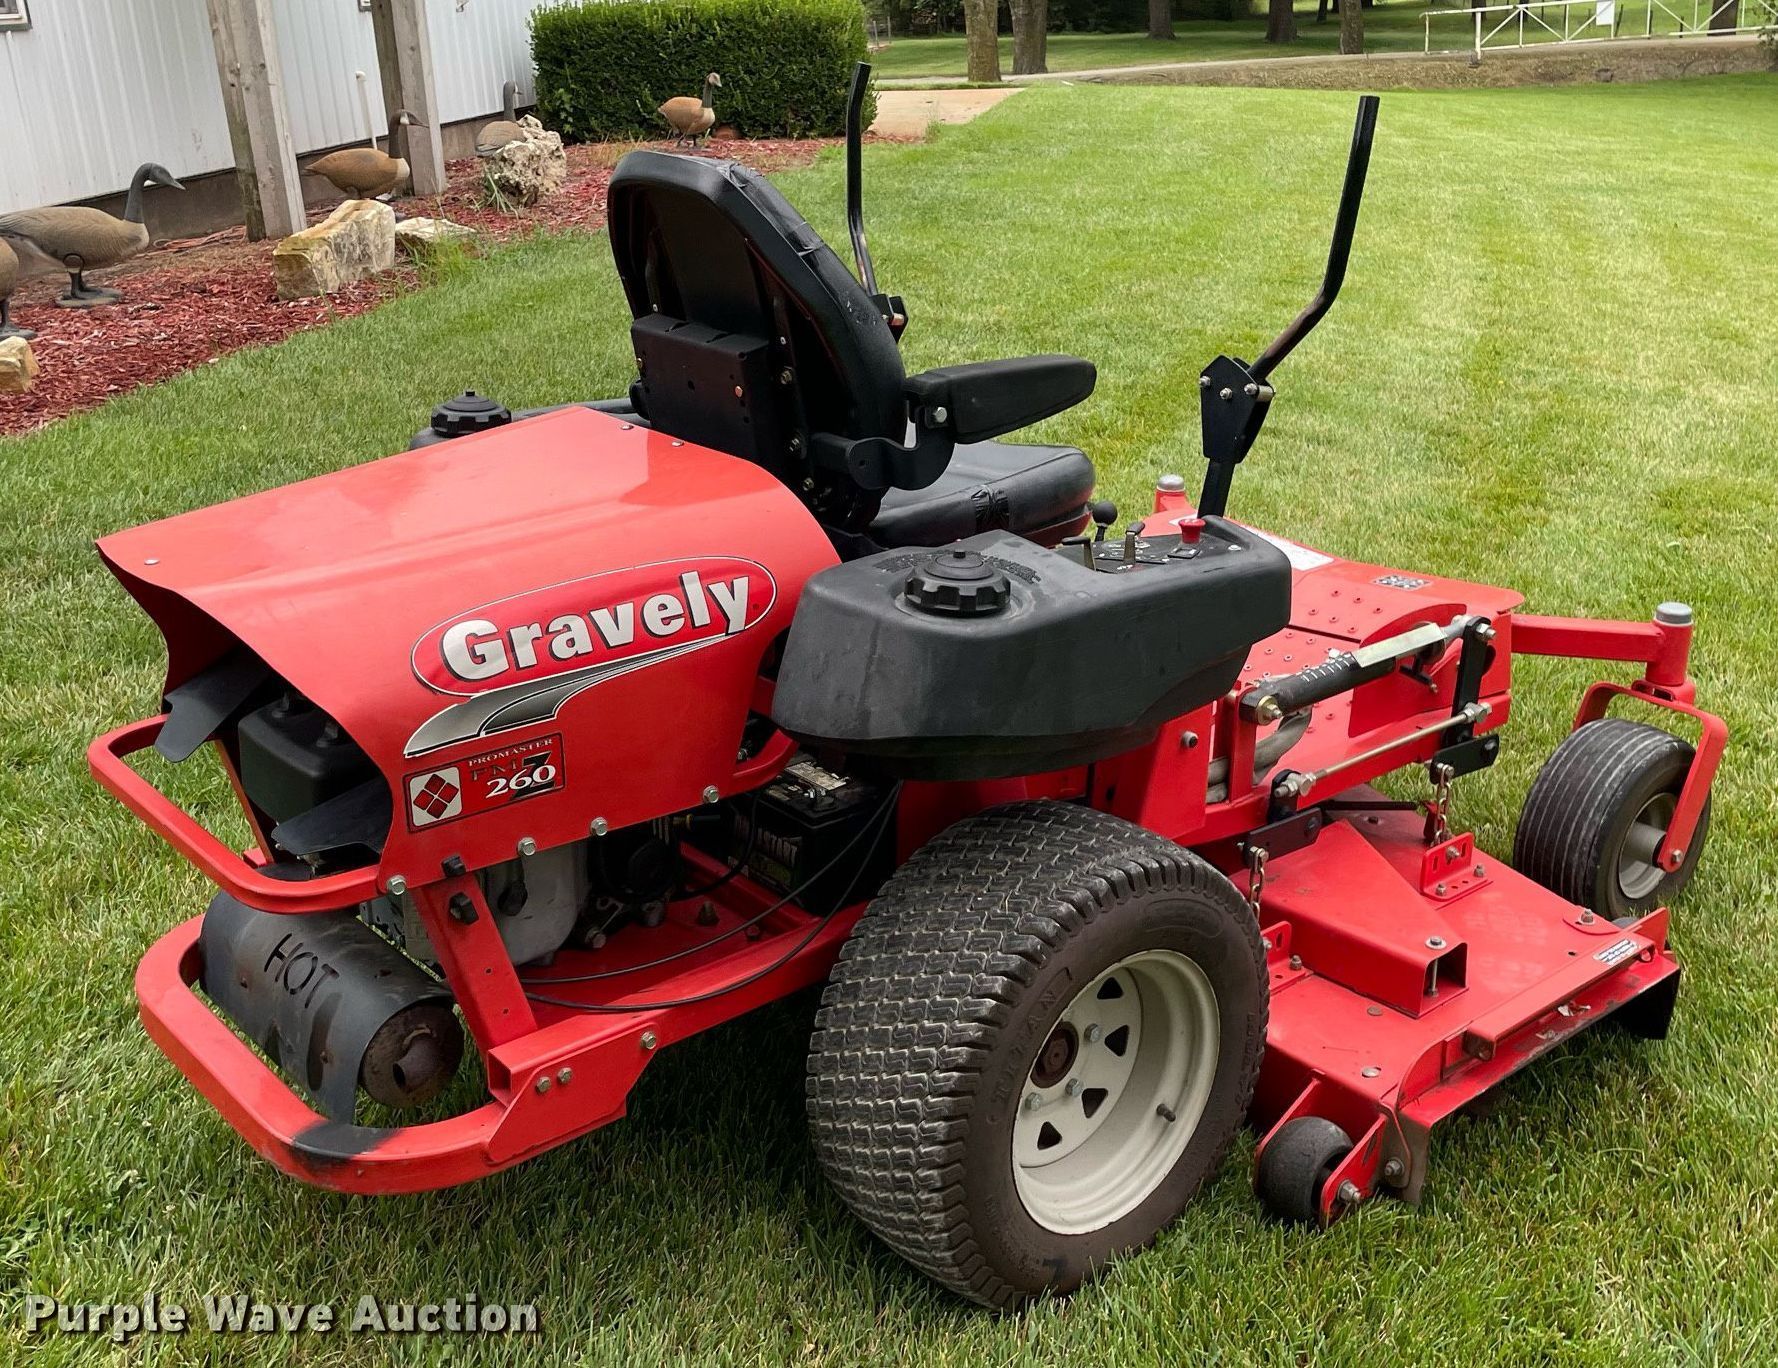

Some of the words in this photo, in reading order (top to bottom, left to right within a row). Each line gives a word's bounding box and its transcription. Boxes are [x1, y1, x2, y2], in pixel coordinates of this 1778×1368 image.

[441, 570, 750, 681] Gravely
[468, 738, 553, 767] PROMASTER
[485, 764, 557, 799] 260
[263, 932, 340, 1009] HOT
